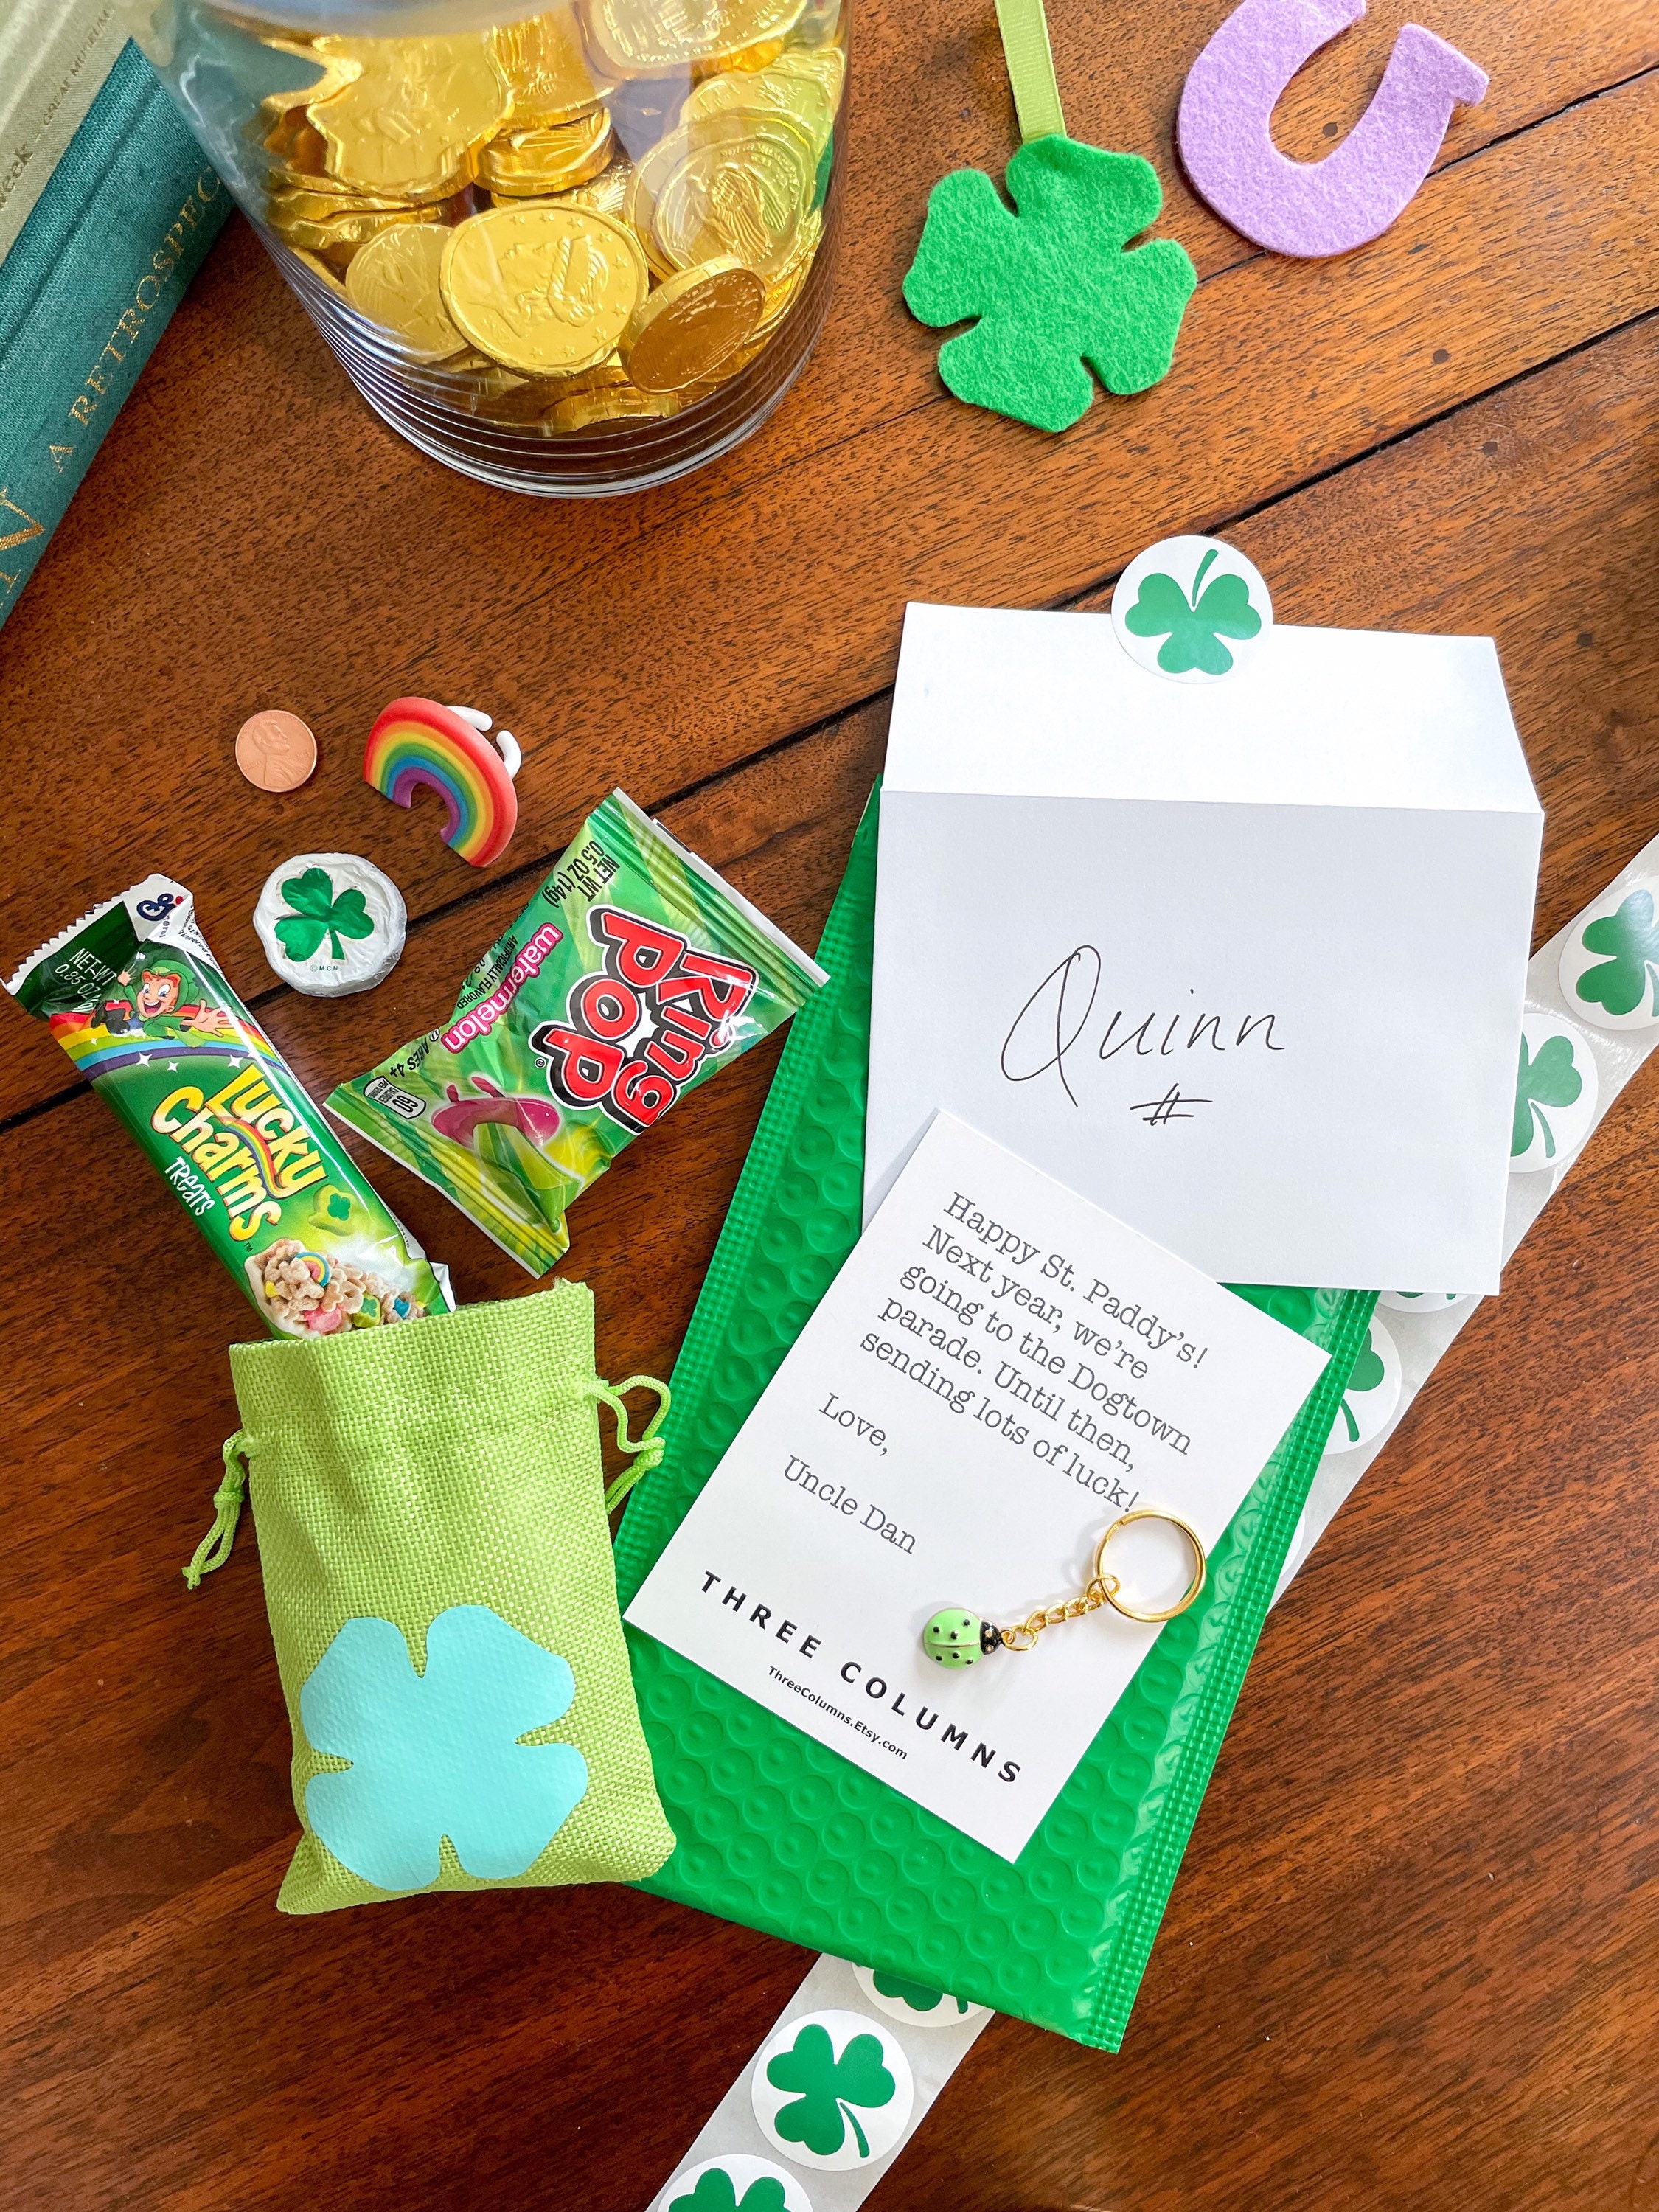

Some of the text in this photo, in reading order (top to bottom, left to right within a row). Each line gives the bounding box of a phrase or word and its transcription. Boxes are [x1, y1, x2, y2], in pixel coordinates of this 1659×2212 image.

[49, 444, 74, 475] A
[542, 841, 605, 908] 0.5 OZ (14g)
[577, 854, 621, 902] NET WT
[55, 964, 101, 1000] 0.85 OZ
[69, 947, 117, 987] NET WT
[442, 924, 562, 1051] watermelon
[457, 978, 493, 1009] FLAVORED
[487, 934, 518, 982] ARTIFICIALLY
[389, 1037, 430, 1077] AGES 4+
[540, 911, 756, 1128] Ring Pop
[1001, 944, 1286, 1107] Quinn
[203, 1063, 329, 1199] Lucky
[392, 1095, 419, 1112] 60
[150, 1085, 282, 1242] Charms
[922, 1225, 992, 1283] Next
[991, 1275, 1063, 1334] year,
[943, 1192, 1040, 1265] Happy
[1040, 1254, 1075, 1292] St.
[877, 1297, 1134, 1472] parade. Until then,
[900, 1266, 1191, 1455] going to the Dogtown
[819, 1392, 888, 1457] Love,
[860, 1333, 1139, 1513] sending lots of luck!
[784, 1454, 916, 1554] Uncle Dan
[702, 1571, 1021, 1783] THREE COLUMNS
[769, 1665, 908, 1760] ThreeColumns.Etsy.com
